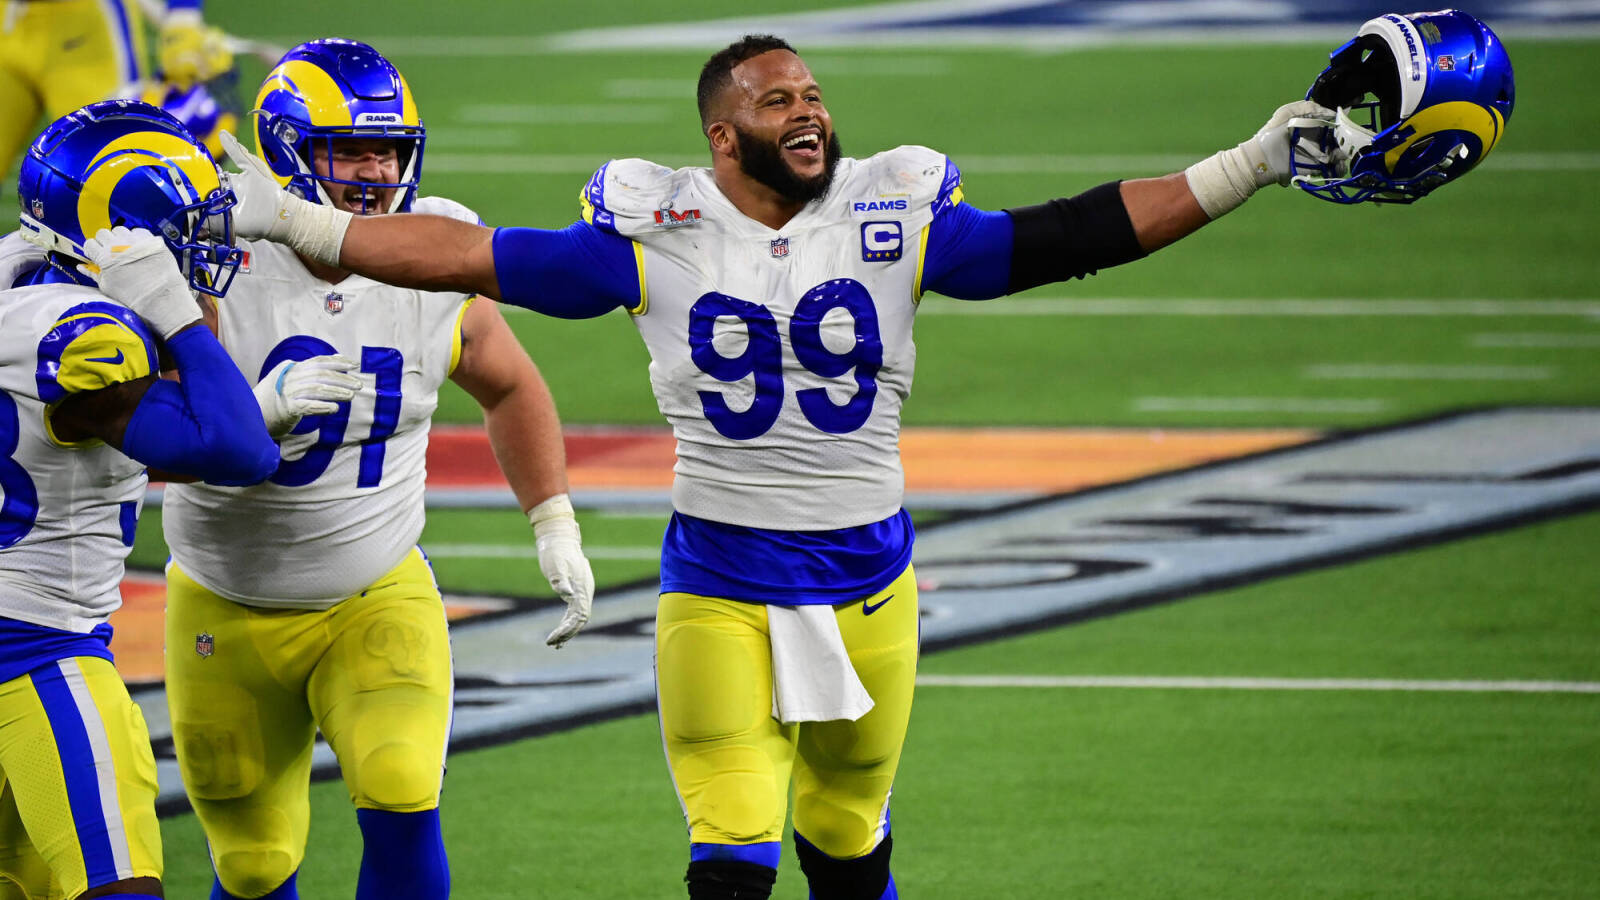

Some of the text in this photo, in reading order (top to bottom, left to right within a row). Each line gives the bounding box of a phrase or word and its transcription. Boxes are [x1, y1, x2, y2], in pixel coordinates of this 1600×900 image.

[854, 200, 907, 212] RAMS
[864, 223, 901, 251] C
[688, 278, 884, 440] 99
[257, 334, 404, 488] 91
